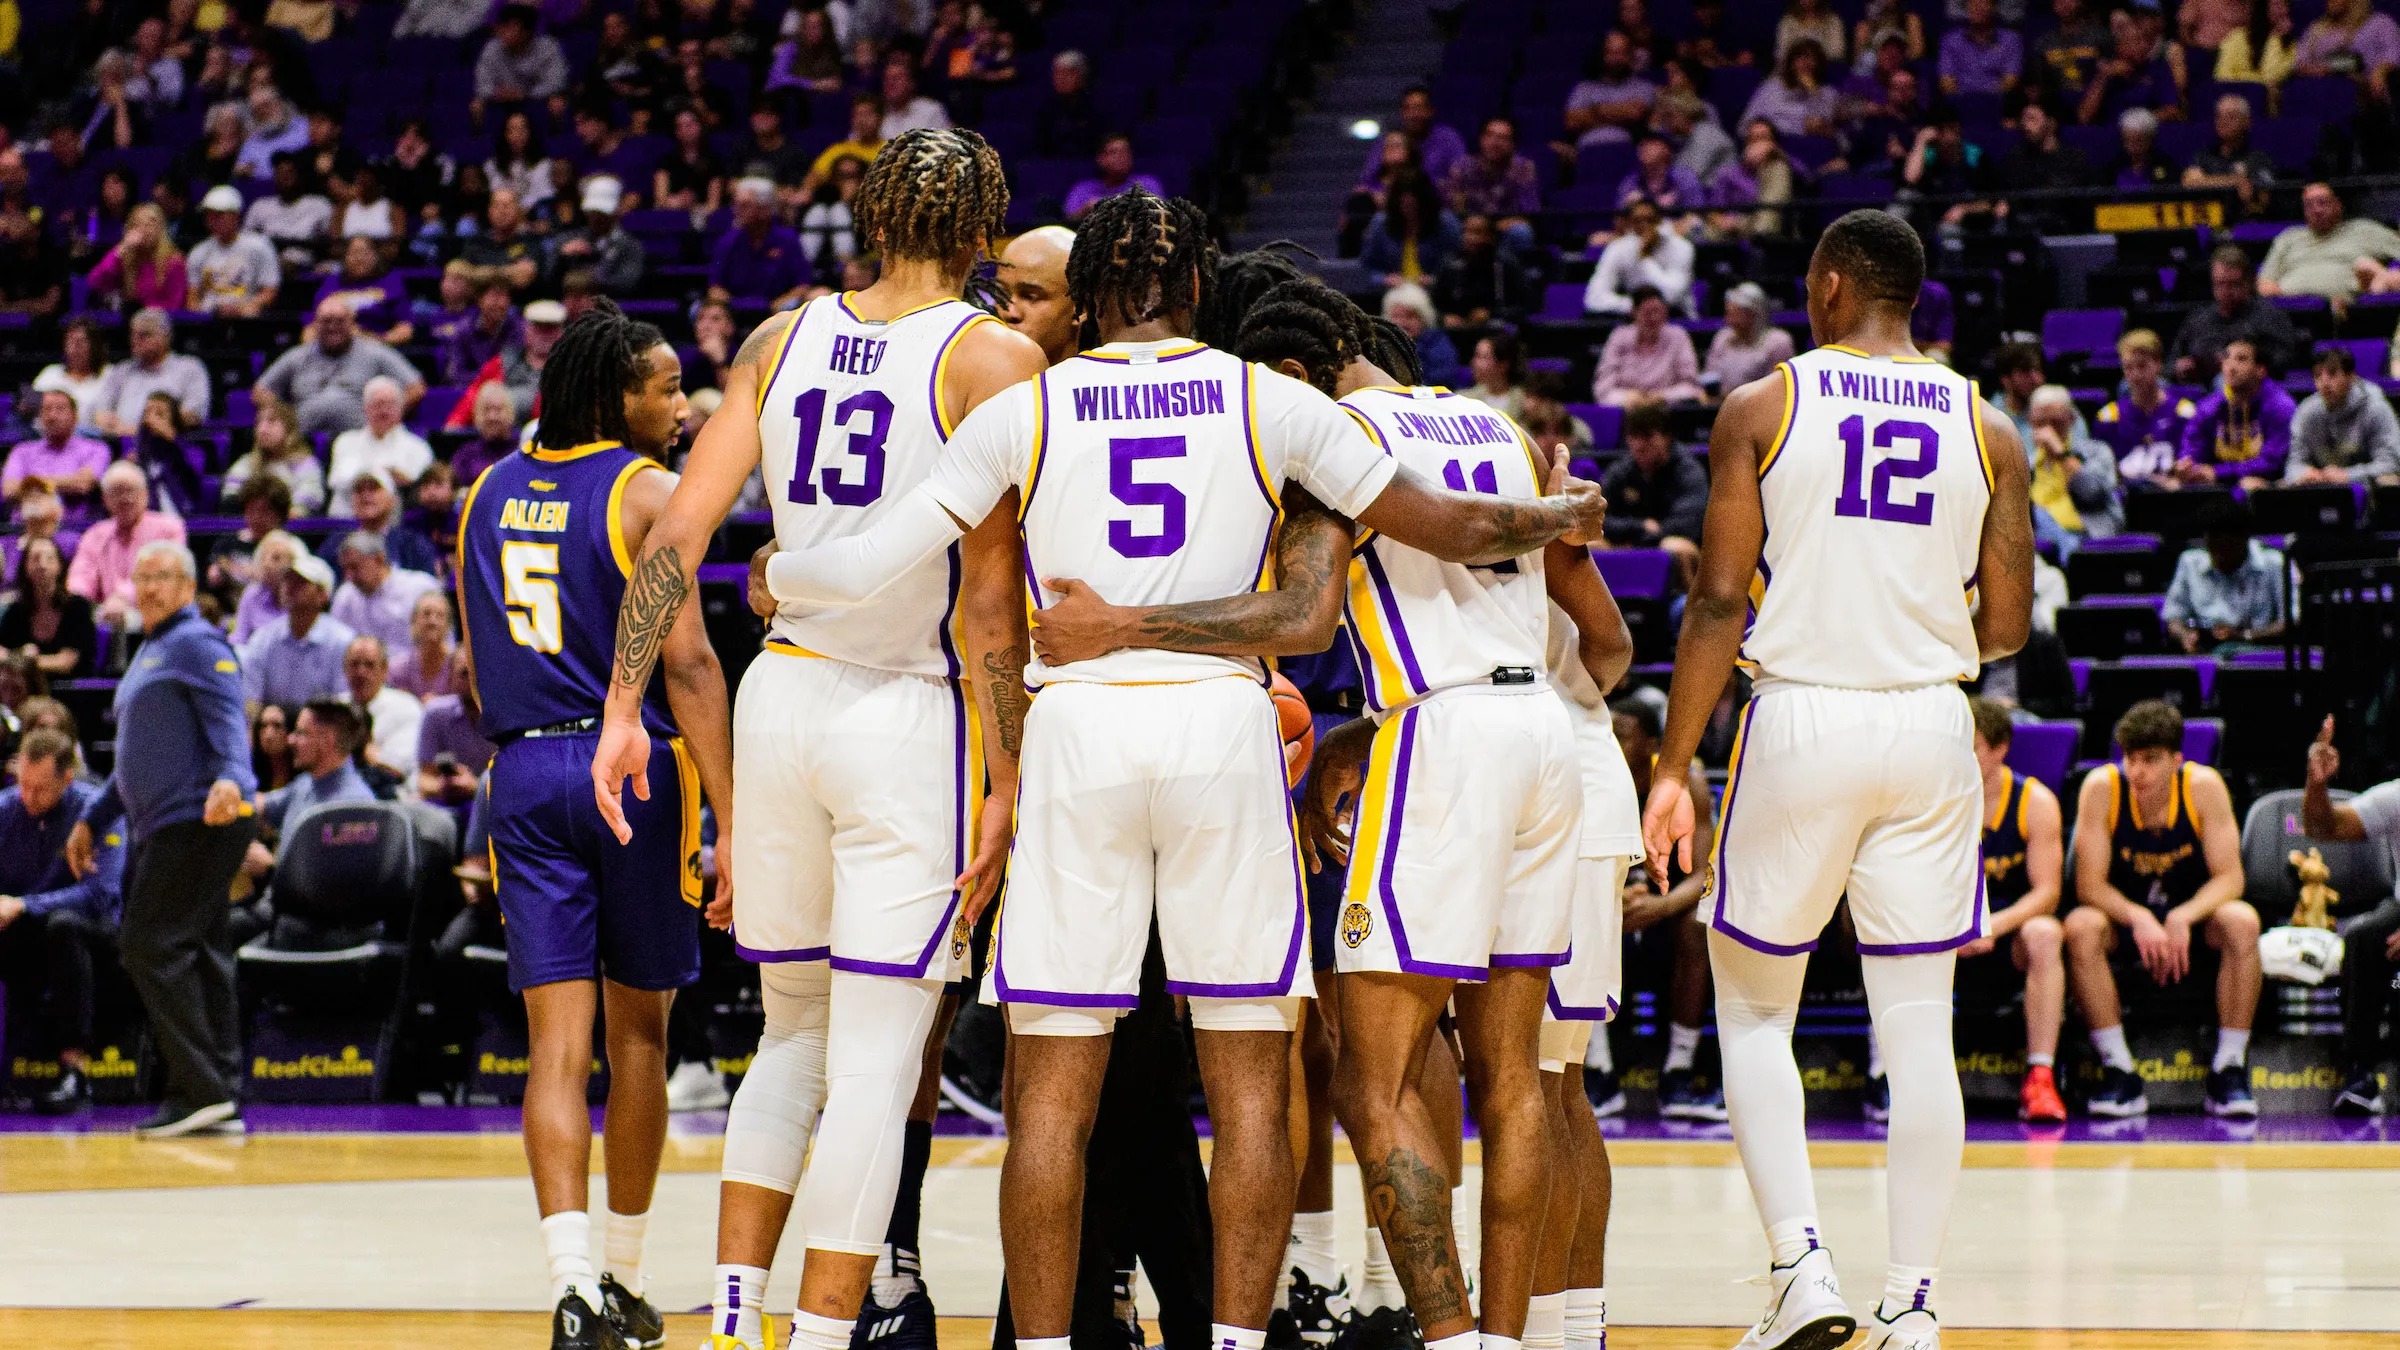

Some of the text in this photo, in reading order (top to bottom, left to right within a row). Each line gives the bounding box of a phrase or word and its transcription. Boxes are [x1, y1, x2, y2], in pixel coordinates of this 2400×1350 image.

[830, 334, 888, 375] REED
[1072, 379, 1225, 422] WILKINSON
[1818, 369, 1951, 413] K.WILLIAMS
[788, 387, 895, 507] 13
[1392, 411, 1513, 446] J.WILLIAMS
[1834, 414, 1939, 526] 12
[499, 497, 570, 533] ALLEN
[1108, 435, 1187, 558] 5
[501, 540, 563, 655] 5
[252, 1045, 375, 1079] RoofClaim
